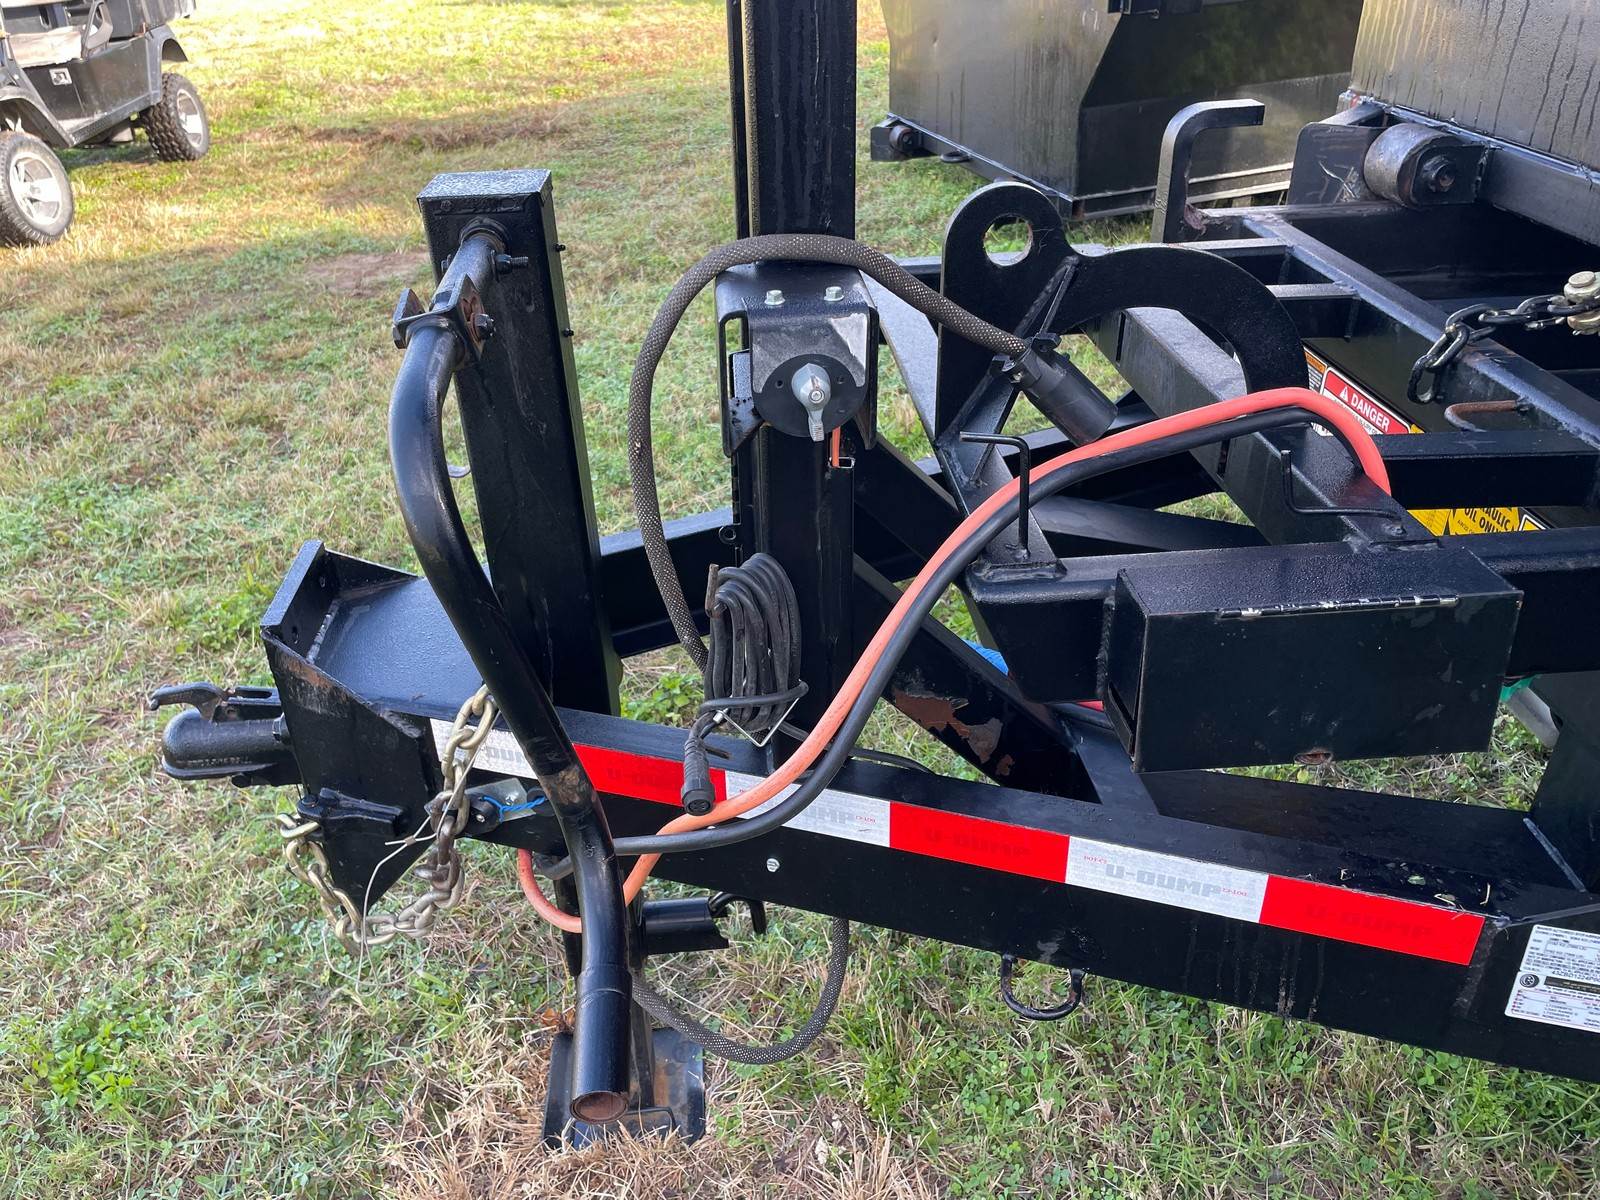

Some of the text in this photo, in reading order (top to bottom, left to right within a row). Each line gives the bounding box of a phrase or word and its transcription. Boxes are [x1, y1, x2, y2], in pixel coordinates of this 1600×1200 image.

[1350, 393, 1390, 432] DANGER
[1482, 507, 1510, 531] AULIC
[1106, 864, 1221, 897] U-DUMP
